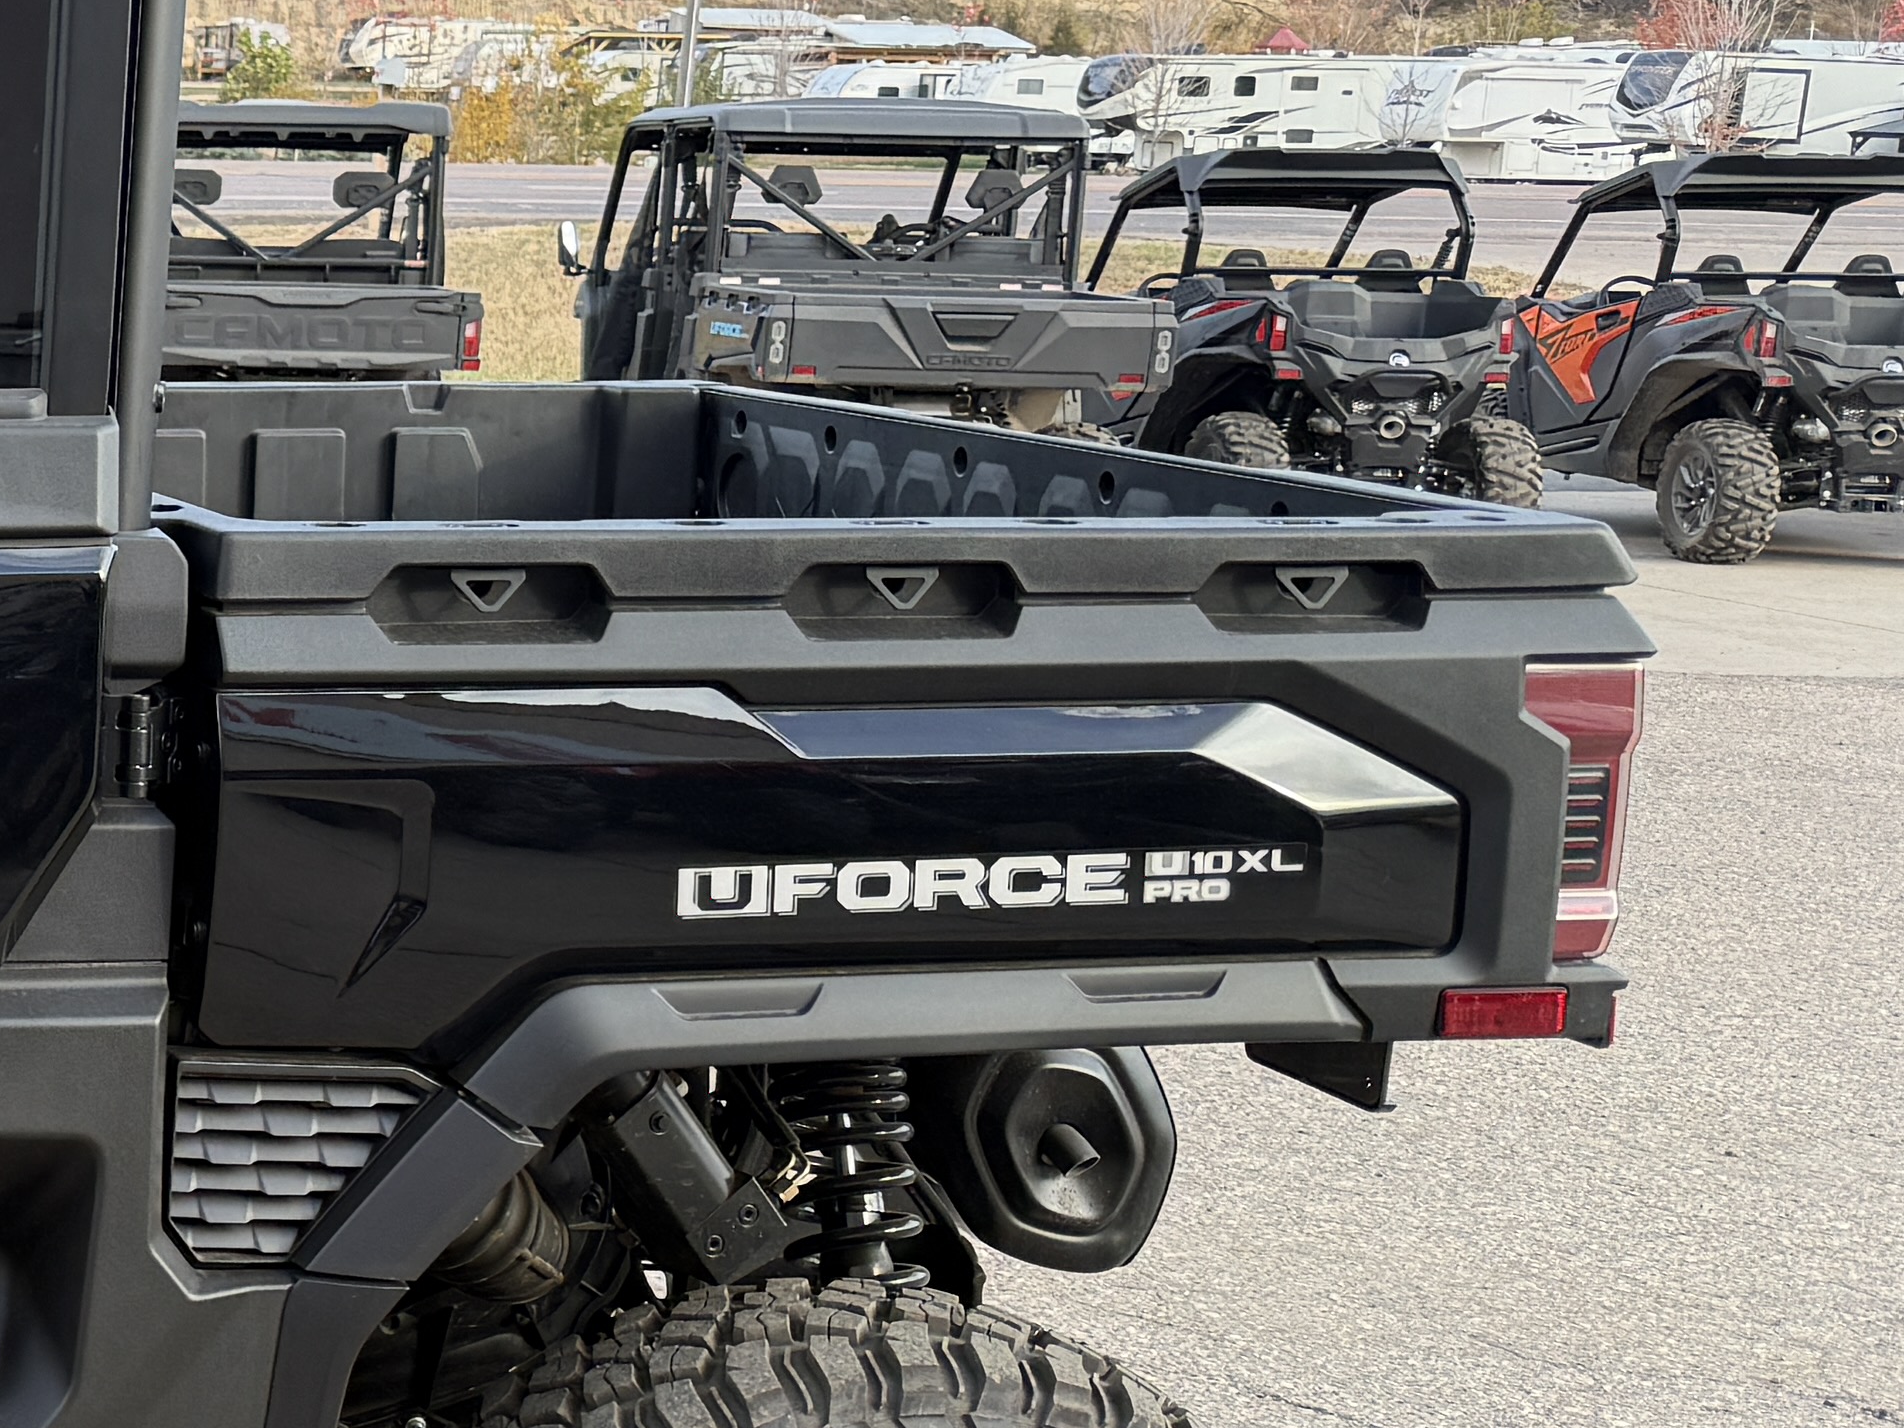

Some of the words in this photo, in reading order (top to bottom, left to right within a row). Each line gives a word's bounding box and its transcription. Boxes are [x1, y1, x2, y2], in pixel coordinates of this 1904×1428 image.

[175, 313, 429, 351] CFMOTO
[676, 852, 1130, 920] UFORCE
[1144, 850, 1233, 876] U10
[1236, 848, 1304, 873] XL
[1143, 878, 1231, 904] PRO
